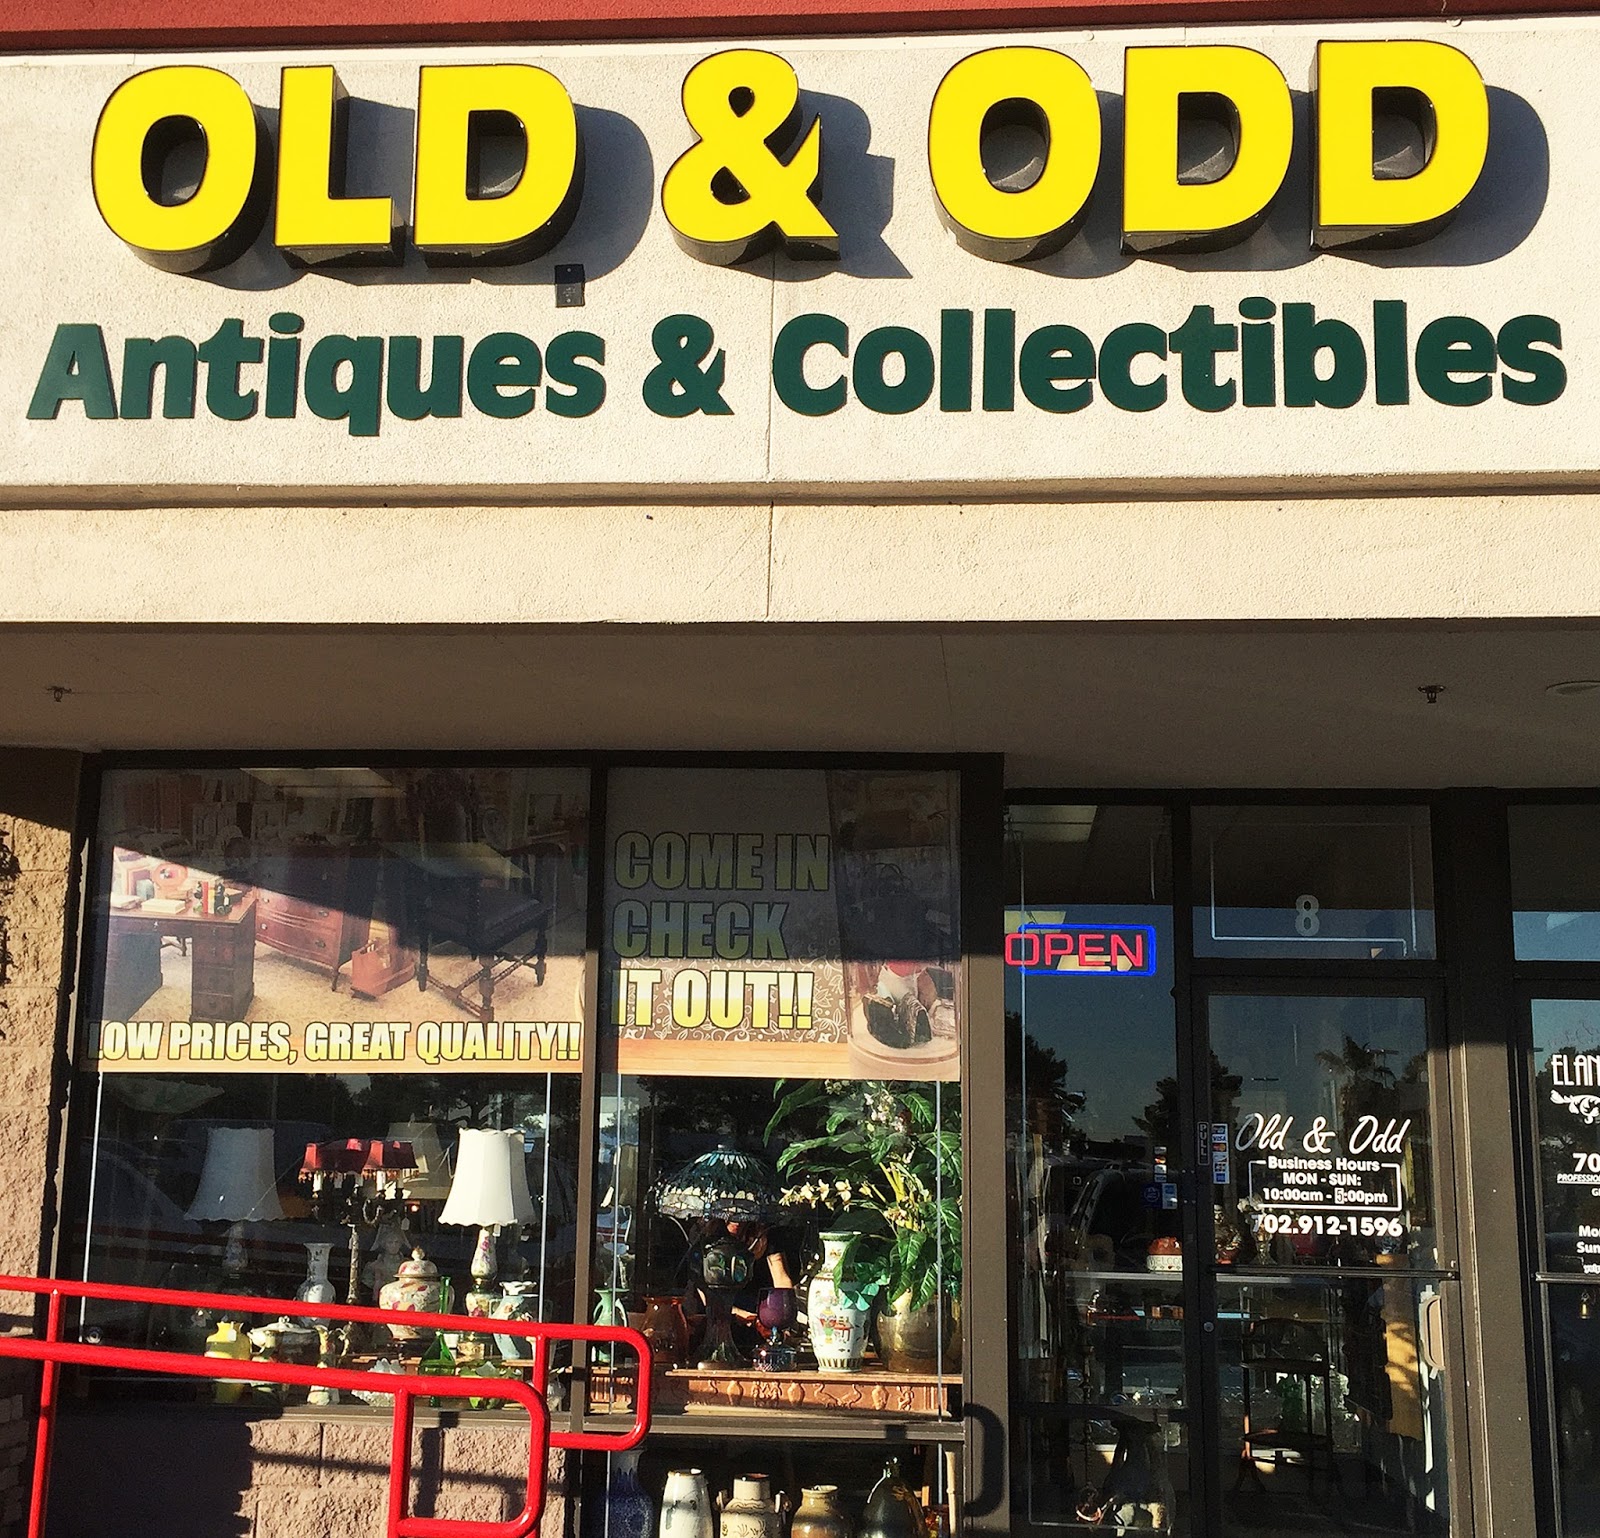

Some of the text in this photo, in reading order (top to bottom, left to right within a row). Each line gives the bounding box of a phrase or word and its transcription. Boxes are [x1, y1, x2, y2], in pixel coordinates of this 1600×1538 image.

[92, 39, 1491, 254] OLD & ODD
[26, 296, 1568, 436] Antiques & Collectibles
[613, 831, 831, 892] COME IN
[612, 899, 789, 960] CHECK
[1295, 893, 1320, 937] 8
[1004, 932, 1144, 968] OPEN
[610, 968, 815, 1030] IT OUT!!
[167, 1021, 299, 1065] PRICES,
[304, 1020, 411, 1061] GREAT
[416, 1020, 583, 1065] QUALITY!!
[1234, 1112, 1412, 1155] Old & Odd
[1267, 1156, 1381, 1173] Business Hours
[1282, 1172, 1318, 1185] MON
[1328, 1173, 1362, 1187] SUN:
[1556, 1173, 1600, 1183] PROFESSIO
[1262, 1187, 1324, 1201] 10:00am
[1334, 1187, 1388, 1205] 5:00pm
[1251, 1213, 1404, 1238] 702.912-1596
[1578, 1224, 1600, 1238] Mo
